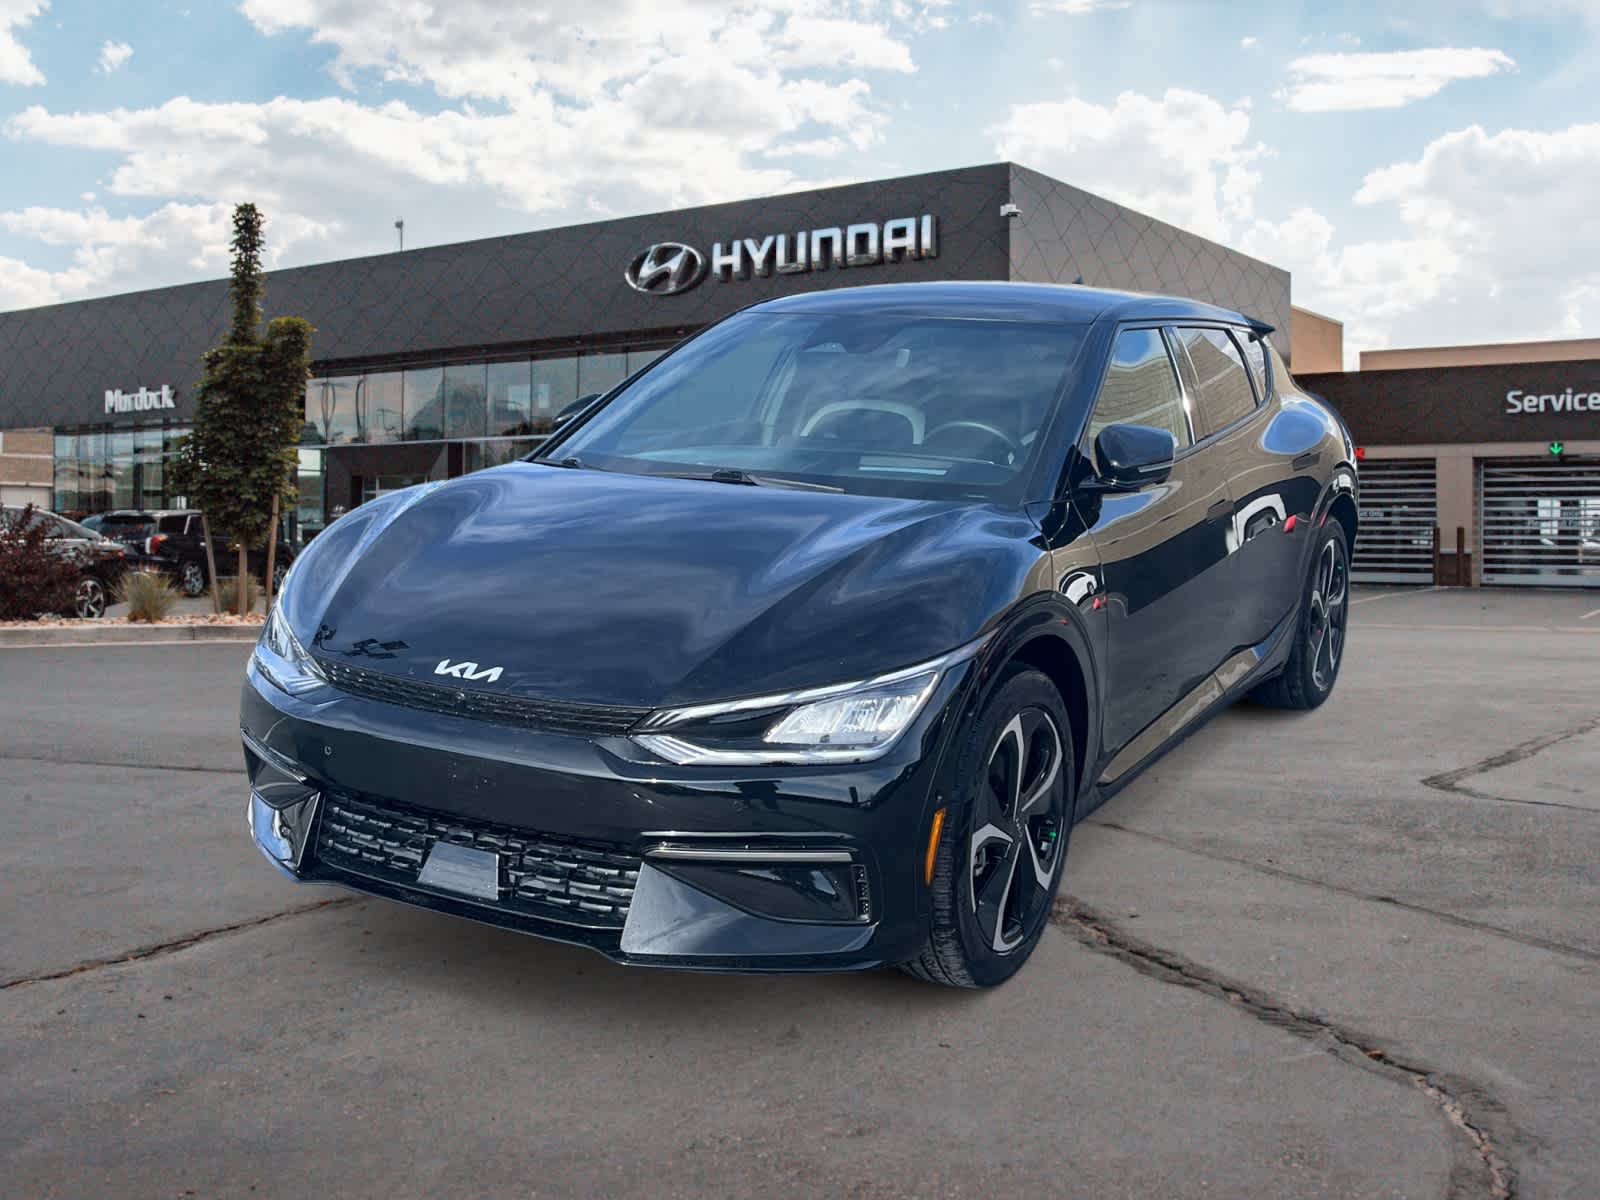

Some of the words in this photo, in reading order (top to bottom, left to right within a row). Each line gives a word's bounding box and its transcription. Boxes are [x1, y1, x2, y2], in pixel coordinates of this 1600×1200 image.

[711, 214, 936, 282] HYUNDAI
[104, 384, 176, 414] Murdock
[1506, 387, 1600, 414] Service
[434, 659, 504, 683] KIA
